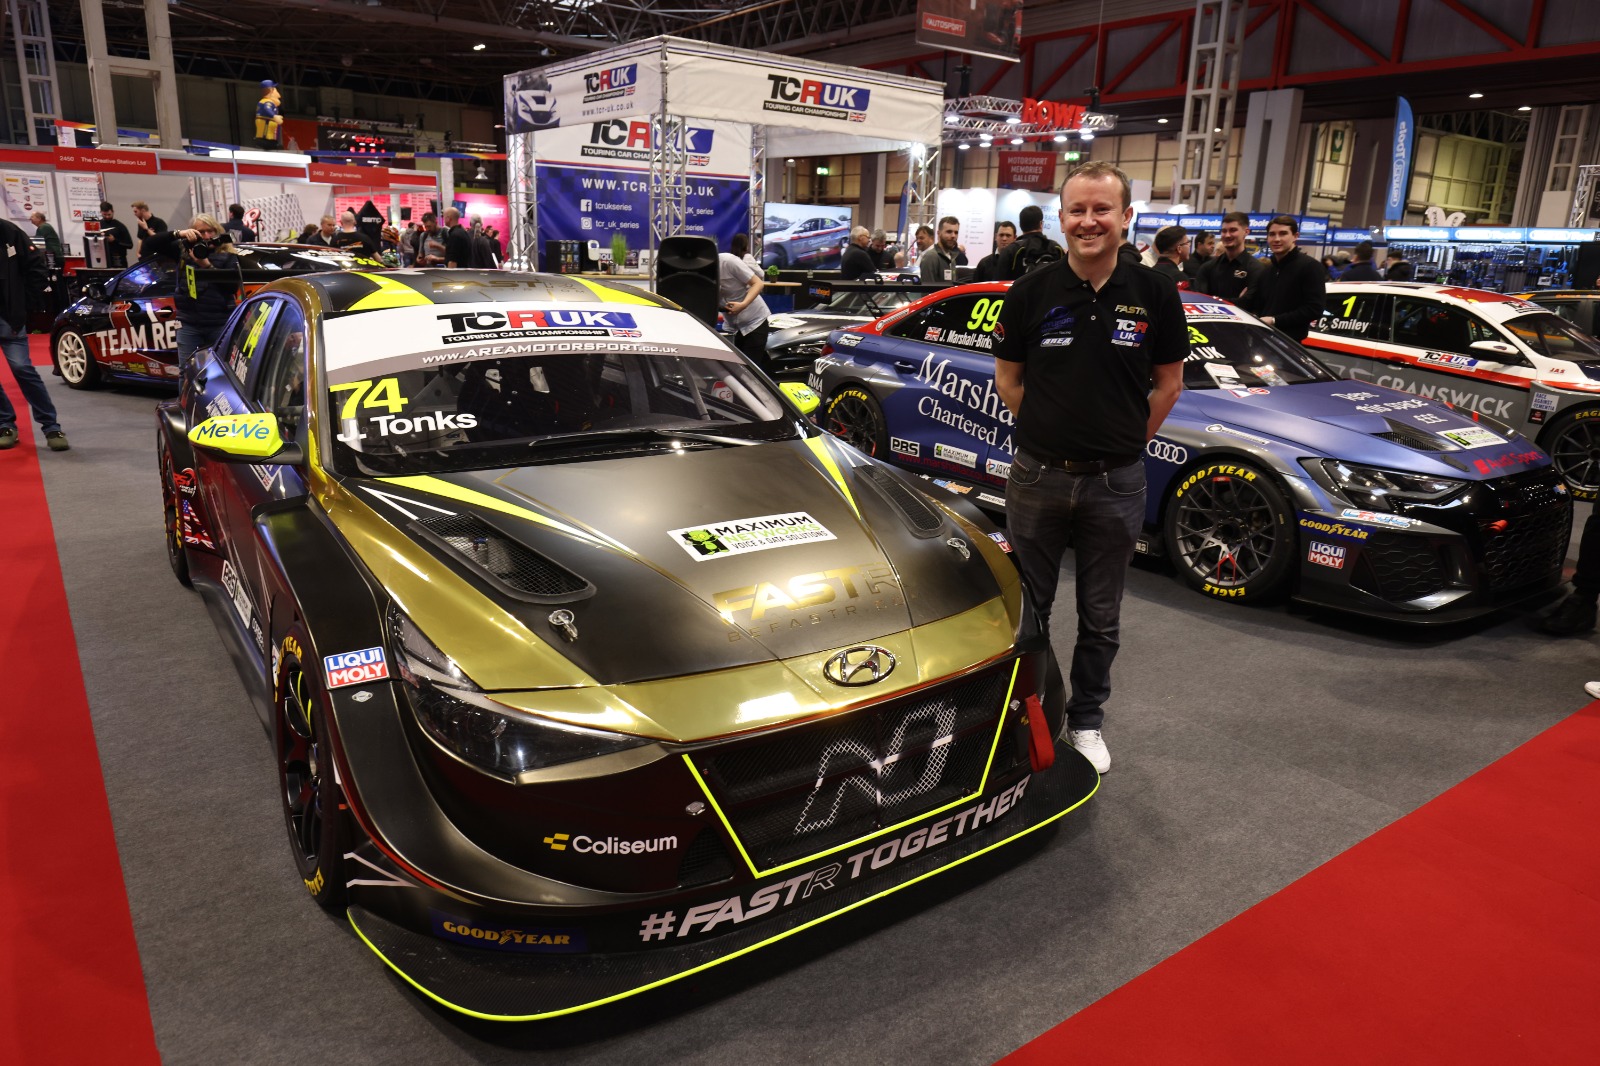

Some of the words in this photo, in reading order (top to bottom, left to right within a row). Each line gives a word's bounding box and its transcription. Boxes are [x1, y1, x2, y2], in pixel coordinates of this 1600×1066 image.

[927, 18, 963, 31] AUTOSPORT
[765, 102, 791, 111] TOURING
[791, 105, 804, 113] CAR
[804, 107, 847, 119] CHAMPIONSHIP
[1022, 97, 1087, 129] ROWE
[92, 157, 116, 165] Creative
[583, 147, 616, 157] TOURING
[617, 150, 633, 158] CAR
[1007, 157, 1048, 166] MOTORSPORT
[1011, 166, 1043, 174] MEMORIES
[1013, 174, 1040, 183] GALLERY
[595, 202, 632, 211] tcrukseries
[362, 216, 382, 224] zamp
[595, 222, 640, 230] tcr_uk_series
[1203, 219, 1222, 227] Tools
[967, 298, 1004, 332] 99
[1342, 295, 1357, 317] 1
[1115, 319, 1149, 333] TCR
[1331, 318, 1370, 333] Smiley
[96, 323, 148, 357] TEAM
[445, 332, 499, 343] TOURING
[499, 330, 524, 338] CAR
[525, 328, 606, 337] CHAMPIONSHIP
[939, 329, 947, 342] J.
[1119, 331, 1137, 341] UK
[808, 372, 823, 393] RMA
[914, 351, 1017, 430] Marsha
[330, 378, 409, 420] 74
[1376, 375, 1514, 419] CRANSWICK
[337, 418, 367, 441] J.
[369, 411, 478, 437] Tonks
[917, 394, 997, 446] Chartered
[196, 420, 270, 441] MeWe
[891, 439, 919, 455] PBS
[942, 446, 969, 460] MAXIMUM
[1486, 453, 1513, 469] Audi
[1509, 450, 1541, 465] Sport
[1176, 466, 1257, 498] GOODYEAR
[714, 515, 813, 537] MAXIMUM
[723, 524, 821, 544] NETWORKS
[1299, 518, 1369, 540] GOODYEAR
[732, 540, 759, 550] VOICE
[766, 535, 785, 545] DATA
[785, 530, 828, 542] SOLUTIONS
[1311, 541, 1345, 557] LIQUI
[1309, 552, 1343, 568] MOLY
[1202, 582, 1246, 597] EAGLE
[328, 649, 382, 670] LIQUI
[331, 662, 384, 685] MOLY
[846, 774, 1034, 880] TOGETHER
[572, 835, 678, 855] Coliseum
[442, 920, 571, 945] GOODYEAR
